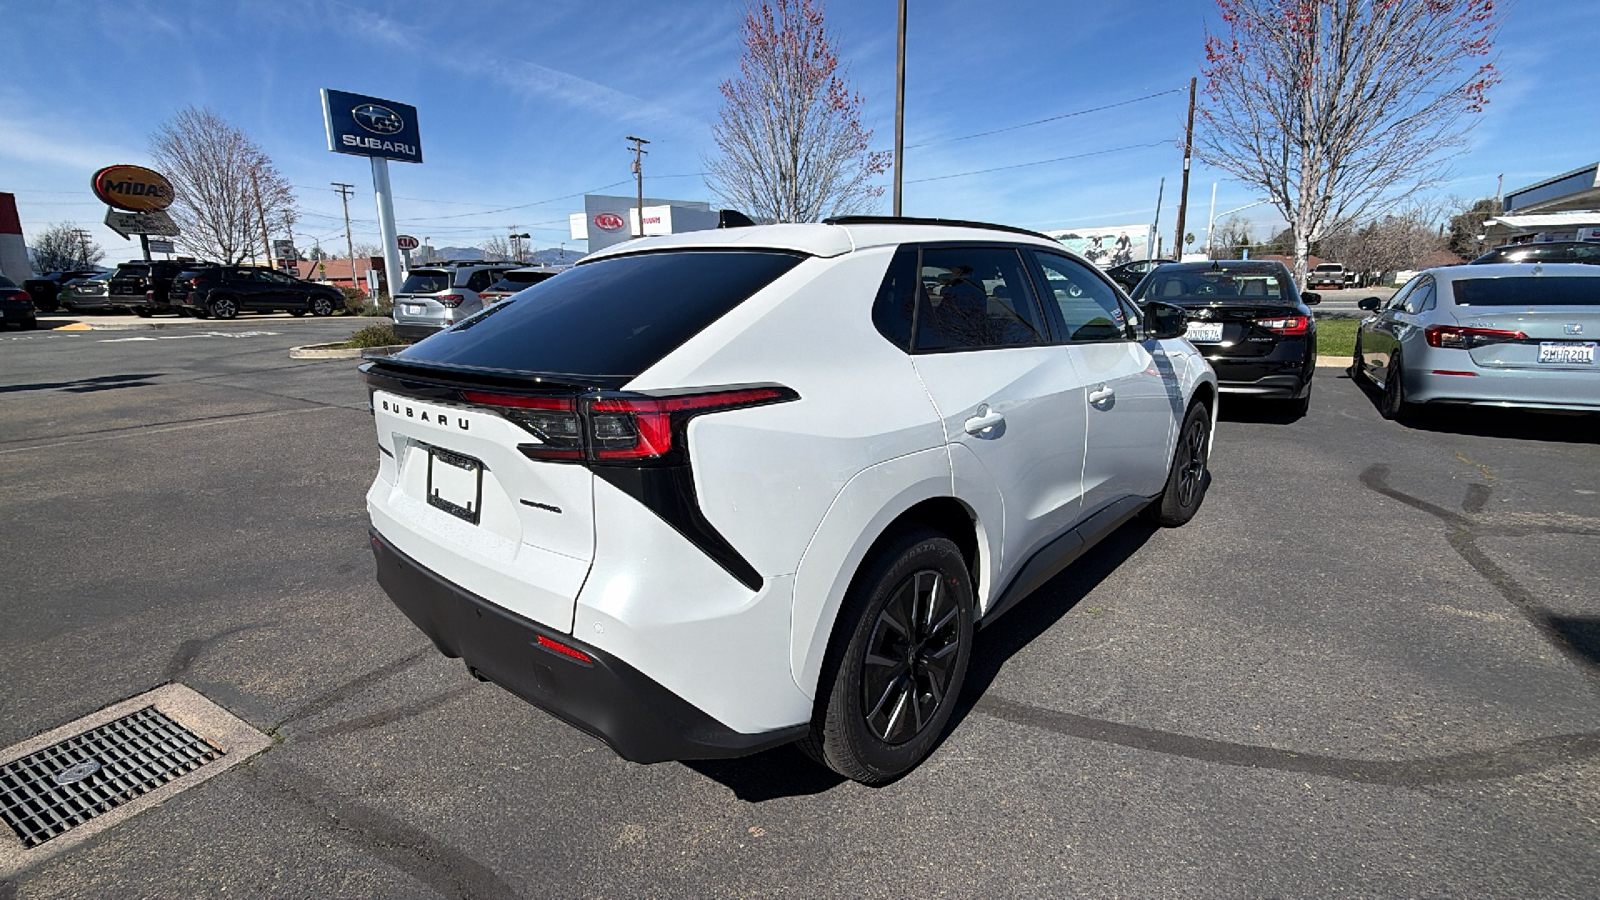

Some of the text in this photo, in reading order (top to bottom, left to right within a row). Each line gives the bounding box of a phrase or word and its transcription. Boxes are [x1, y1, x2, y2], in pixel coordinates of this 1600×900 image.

[342, 134, 416, 156] SUBARU
[398, 238, 417, 249] KIA
[1543, 349, 1590, 361] 9MHR201
[382, 400, 469, 431] SUBARU
